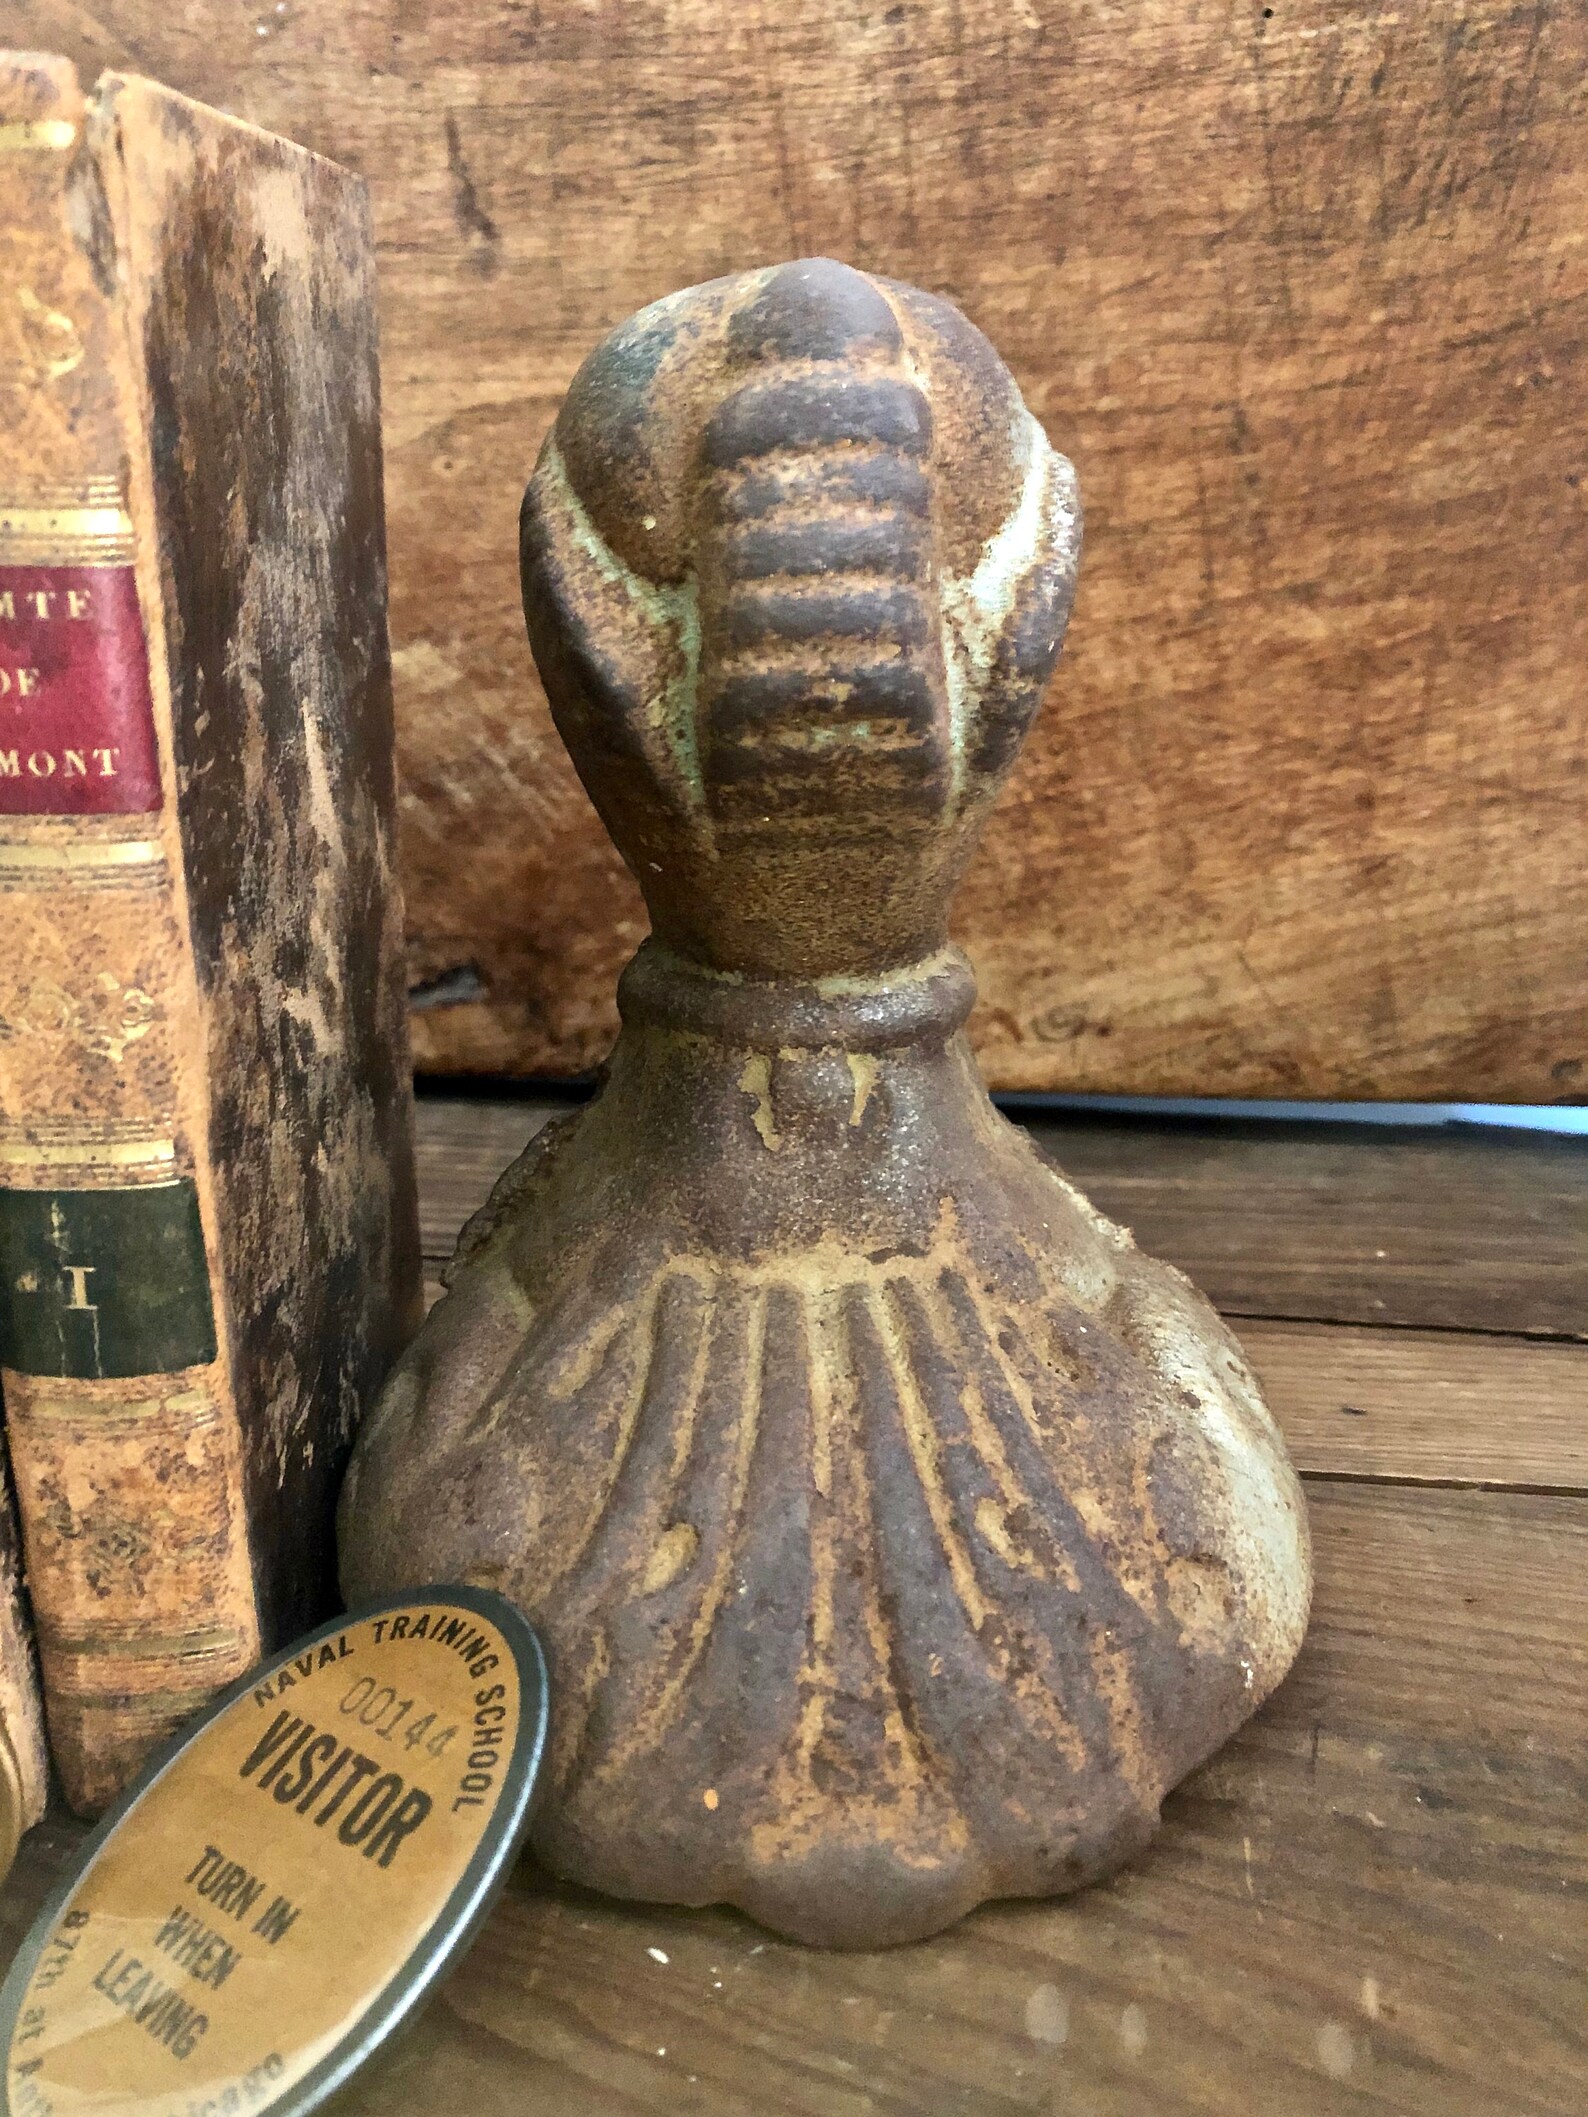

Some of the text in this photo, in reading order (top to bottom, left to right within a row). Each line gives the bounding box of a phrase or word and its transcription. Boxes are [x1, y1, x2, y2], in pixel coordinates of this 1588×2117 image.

[0, 748, 120, 778] MONT
[253, 1613, 506, 1812] NAVAL TRAINING SCHOOL
[339, 1676, 459, 1758] 00144
[239, 1708, 433, 1869] VISITOR
[184, 1844, 302, 1945] TURN IN
[154, 1903, 244, 1991] WHEN
[91, 1947, 209, 2061] LEAVING
